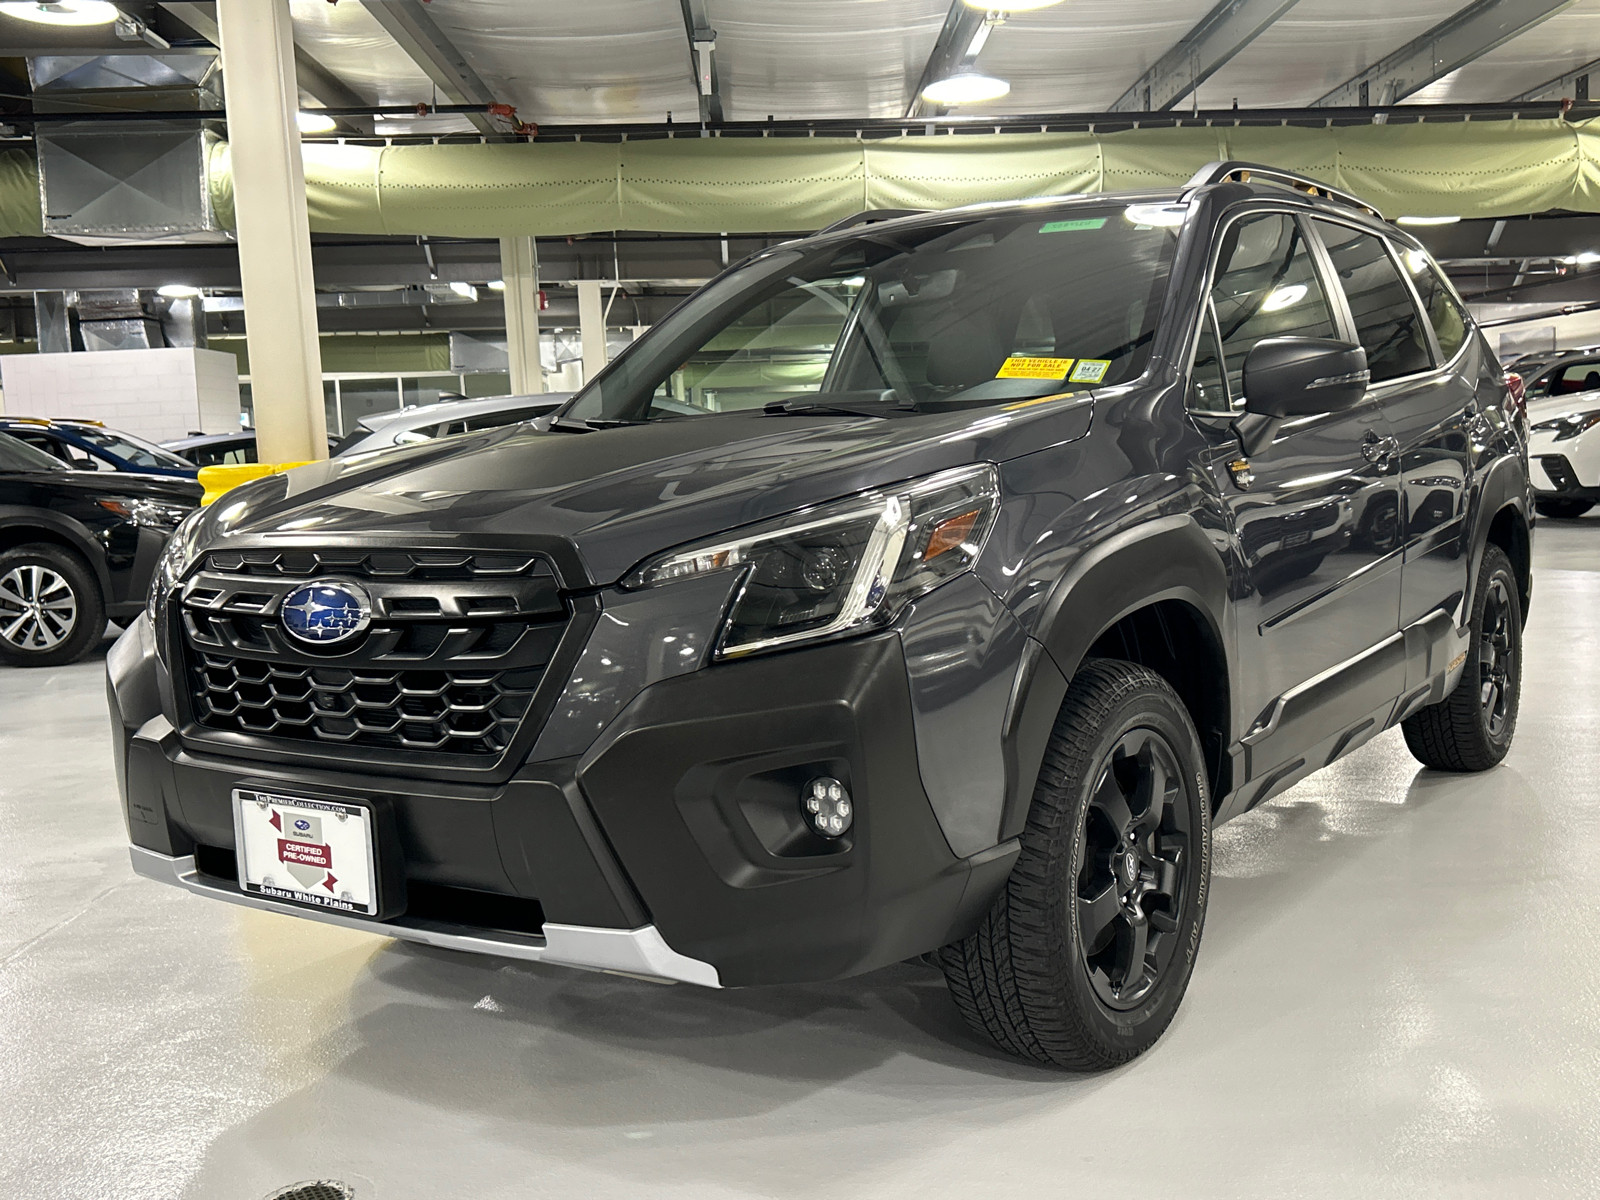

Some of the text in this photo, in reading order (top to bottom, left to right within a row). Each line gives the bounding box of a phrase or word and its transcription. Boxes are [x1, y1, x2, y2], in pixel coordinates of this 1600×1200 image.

[292, 830, 314, 839] SUBARU
[283, 851, 327, 865] PRE-OWNED
[285, 843, 323, 855] CERTIFIED
[1070, 799, 1087, 943] YOKOHAMA
[1185, 771, 1208, 964] GEOLANDAR A/T
[259, 885, 354, 911] Subaru White Plains
